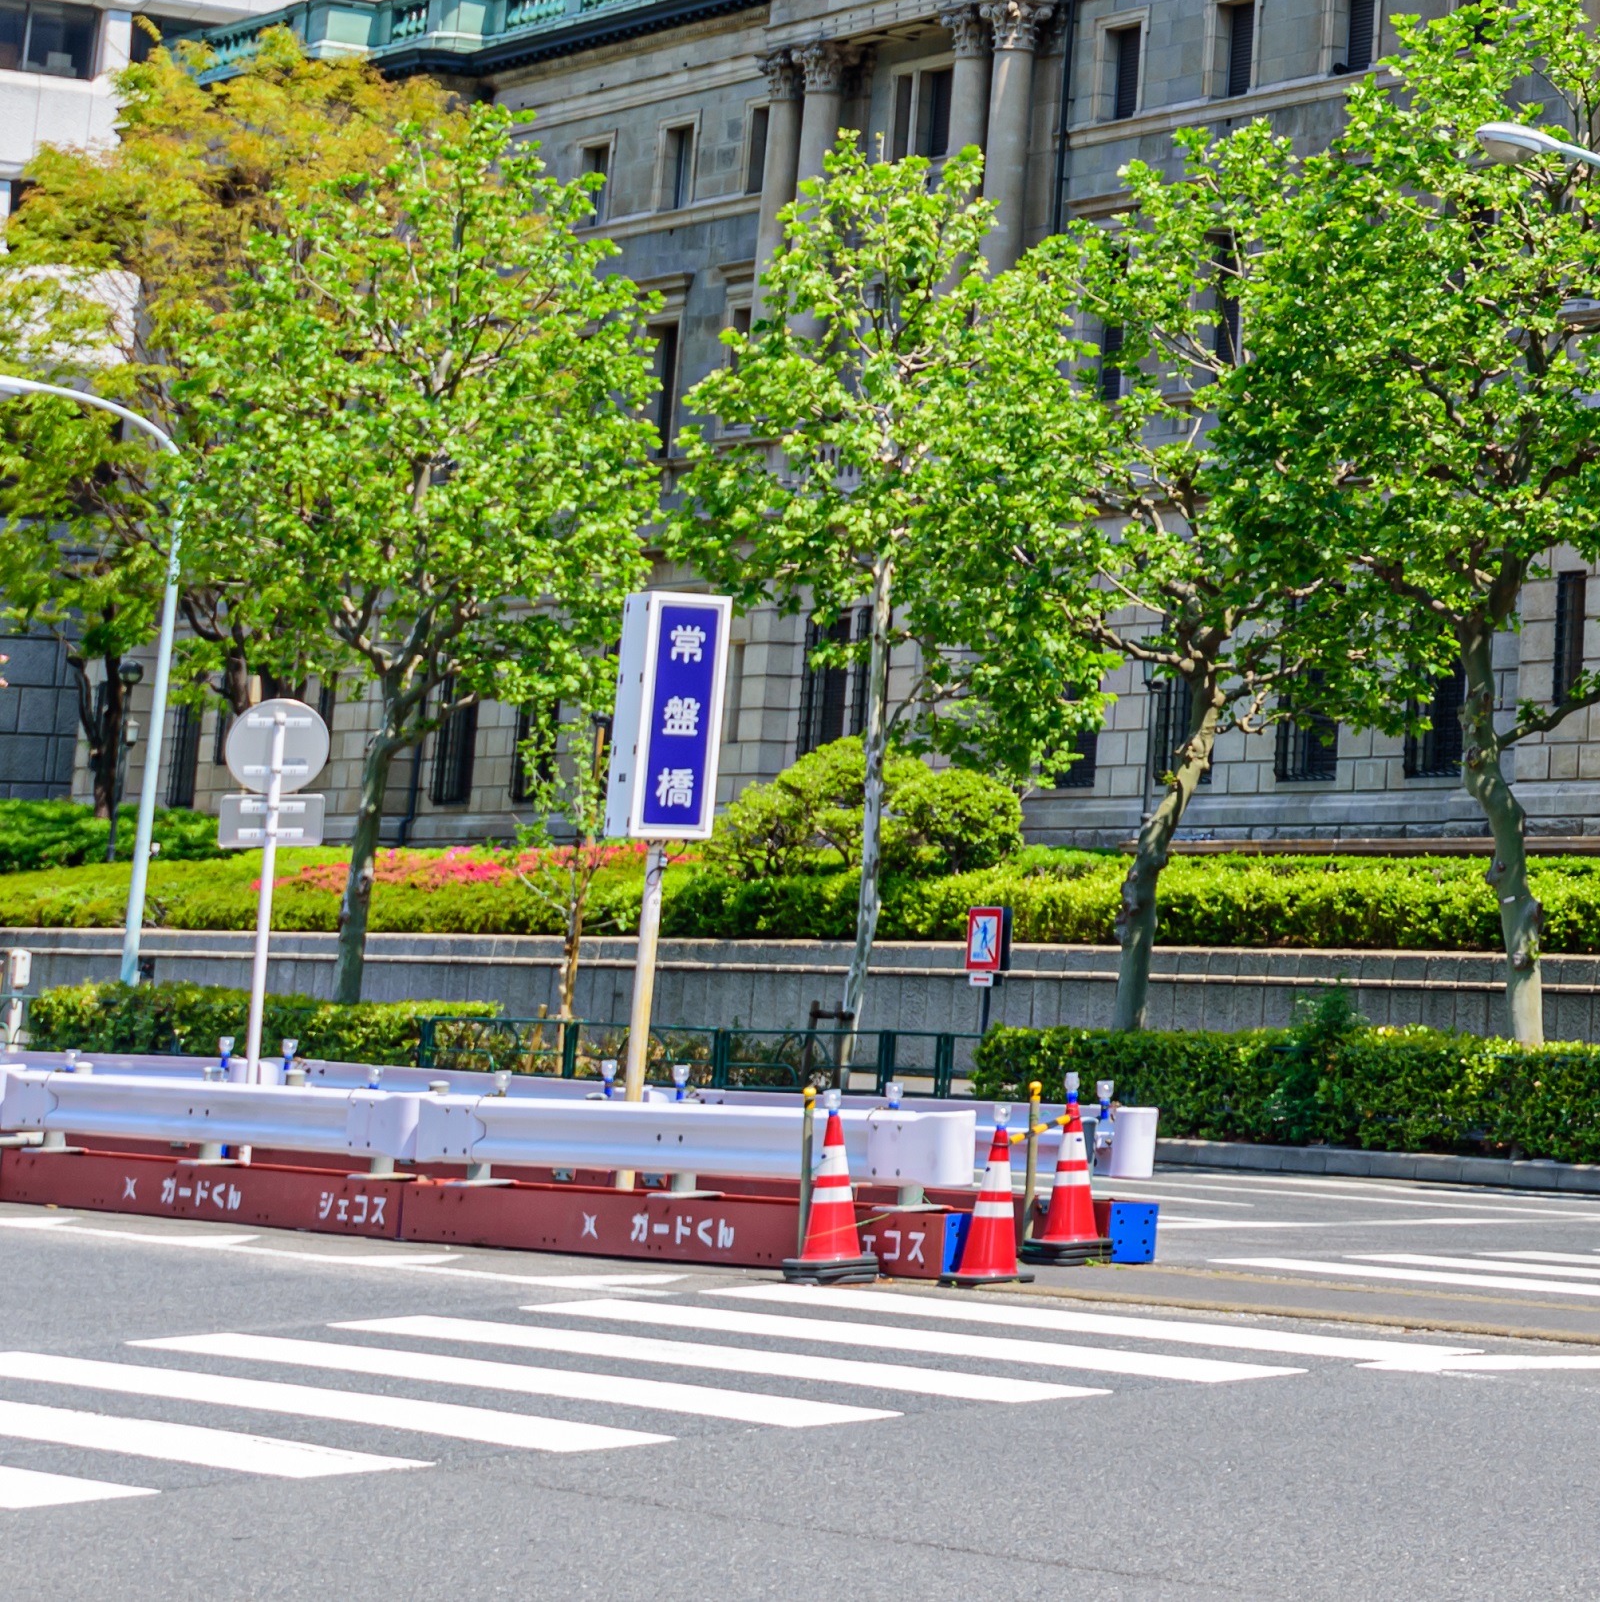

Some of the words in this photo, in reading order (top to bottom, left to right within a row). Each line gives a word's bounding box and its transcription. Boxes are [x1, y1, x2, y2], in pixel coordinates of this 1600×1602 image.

[656, 625, 706, 808] 常盤橋
[161, 1178, 242, 1211] ガードくん
[630, 1213, 735, 1248] ガードくん
